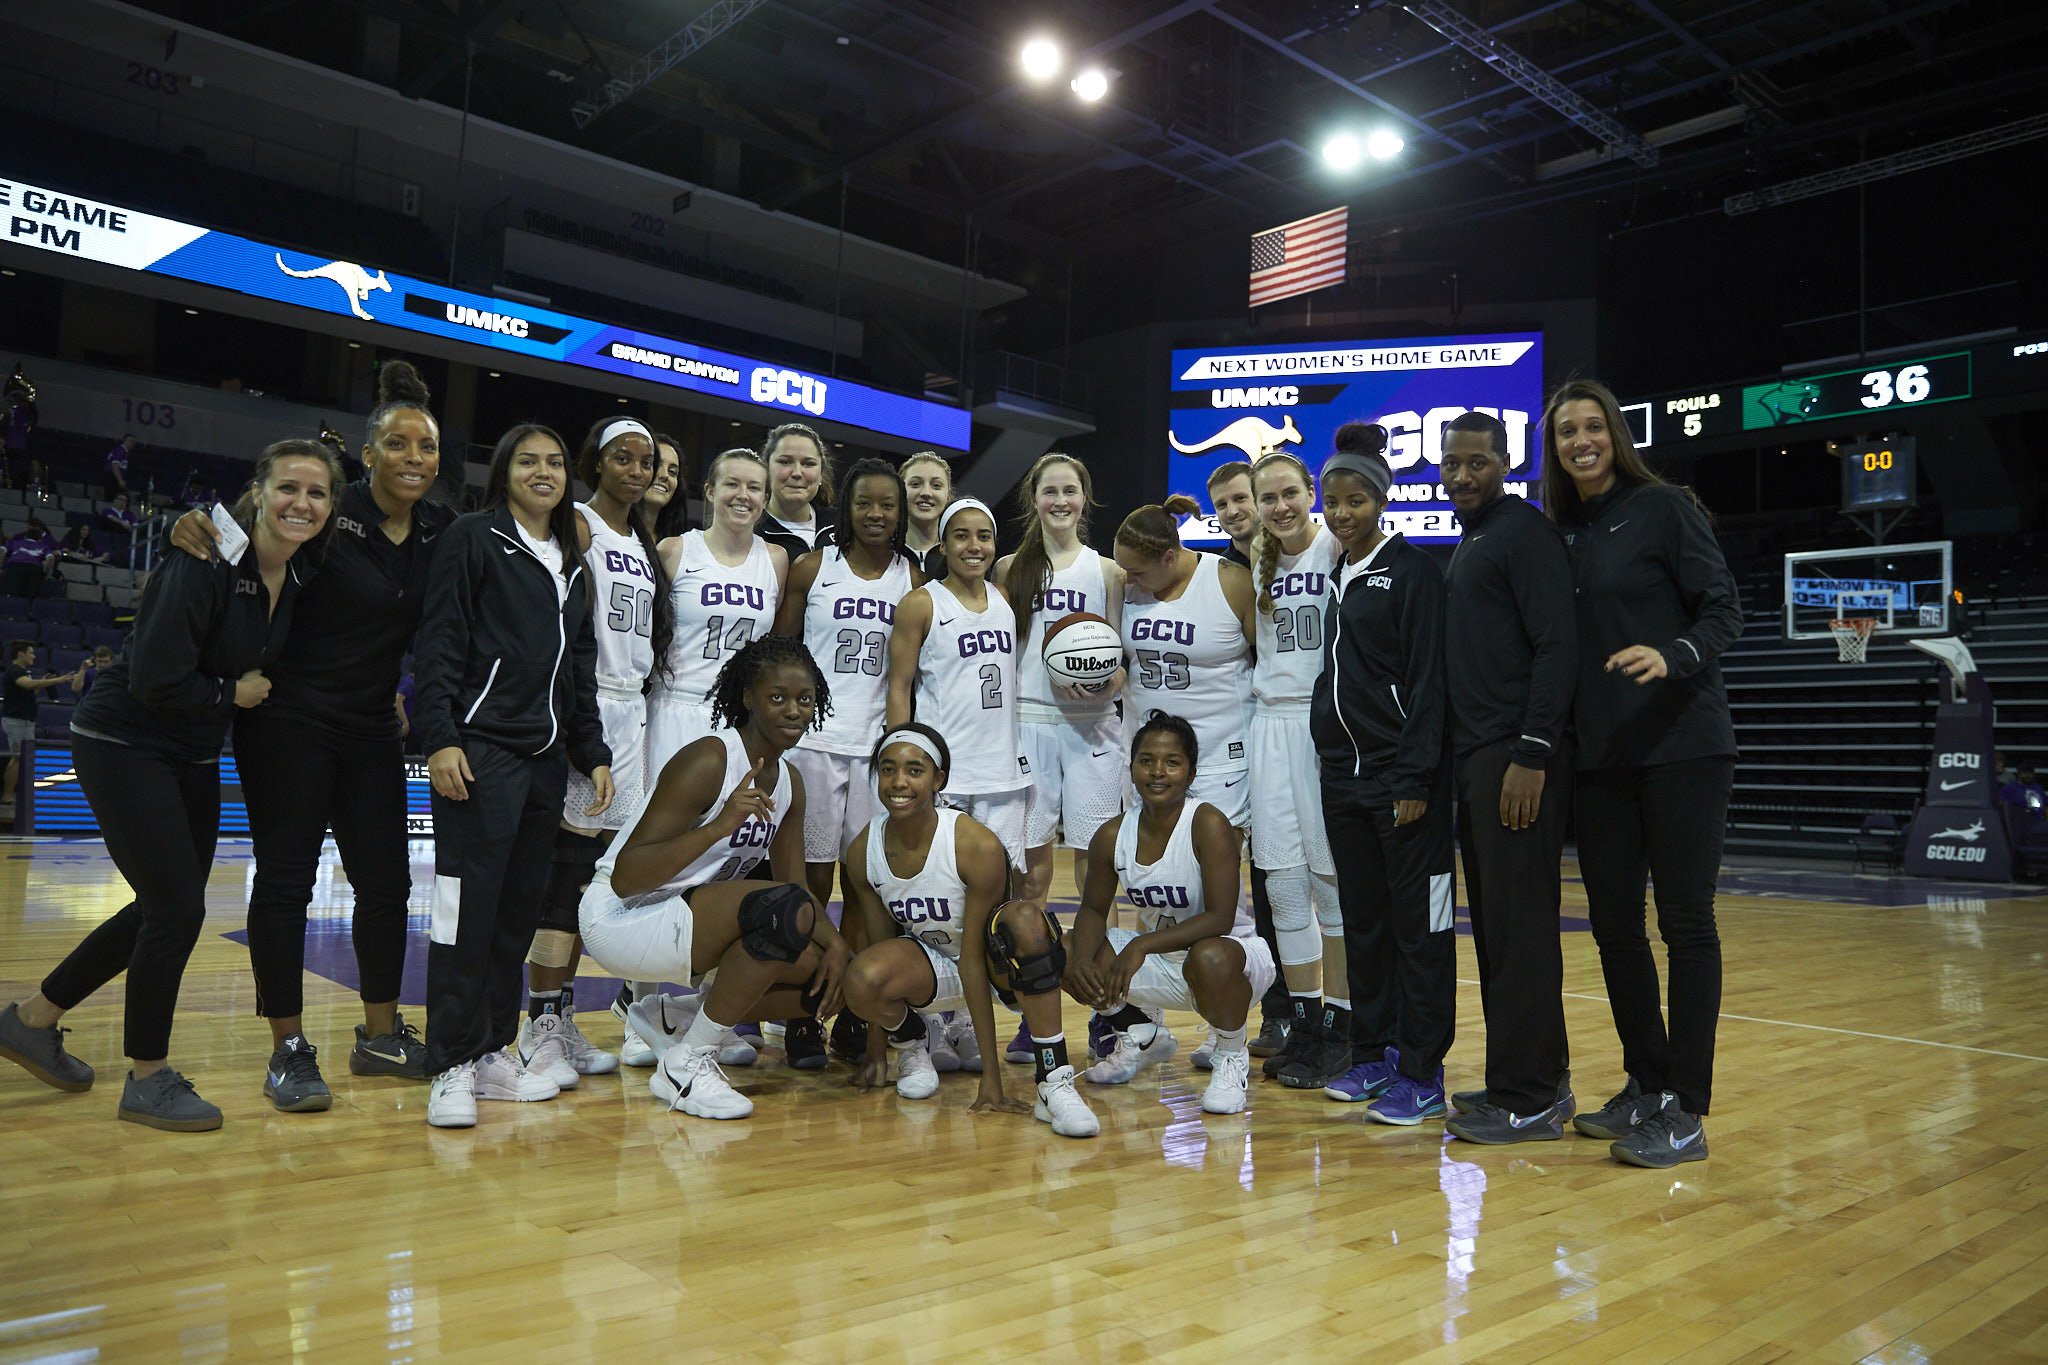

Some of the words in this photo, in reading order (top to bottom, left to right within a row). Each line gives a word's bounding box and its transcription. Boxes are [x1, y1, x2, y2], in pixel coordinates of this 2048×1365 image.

[127, 62, 178, 95] 203
[23, 190, 127, 233] GAME
[630, 212, 664, 237] 202
[10, 216, 80, 251] PM
[446, 303, 529, 338] UMKC
[611, 343, 671, 369] GRAND
[674, 358, 739, 385] CANYON
[1210, 359, 1260, 373] NEXT
[1266, 354, 1364, 370] WOMEN'S
[1371, 351, 1432, 366] HOME
[1440, 347, 1502, 363] GAME
[750, 367, 827, 415] GCU
[1212, 385, 1299, 408] UMKC
[1860, 364, 1930, 408] 36
[123, 399, 175, 429] 103
[1667, 393, 1720, 414] FOULS
[1683, 413, 1702, 436] 5
[605, 550, 655, 584] GCU
[234, 578, 258, 596] CU
[701, 583, 764, 611] GCU
[1267, 572, 1325, 600] GCU
[1366, 575, 1393, 590] GCU
[608, 581, 653, 638] 50
[833, 597, 896, 626] GCU
[703, 615, 756, 660] 14
[1131, 618, 1196, 646] GCU
[1272, 605, 1322, 653] 20
[834, 628, 886, 677] 23
[958, 630, 1012, 659] GCU
[1064, 656, 1117, 672] Wilson
[1136, 649, 1191, 690] 53
[979, 664, 1003, 710] 2
[1939, 752, 1980, 769] GCU
[729, 821, 777, 849] GCU
[1926, 845, 1987, 863] GCU.EDU
[889, 897, 951, 923] GCU
[1127, 885, 1190, 909] GCU
